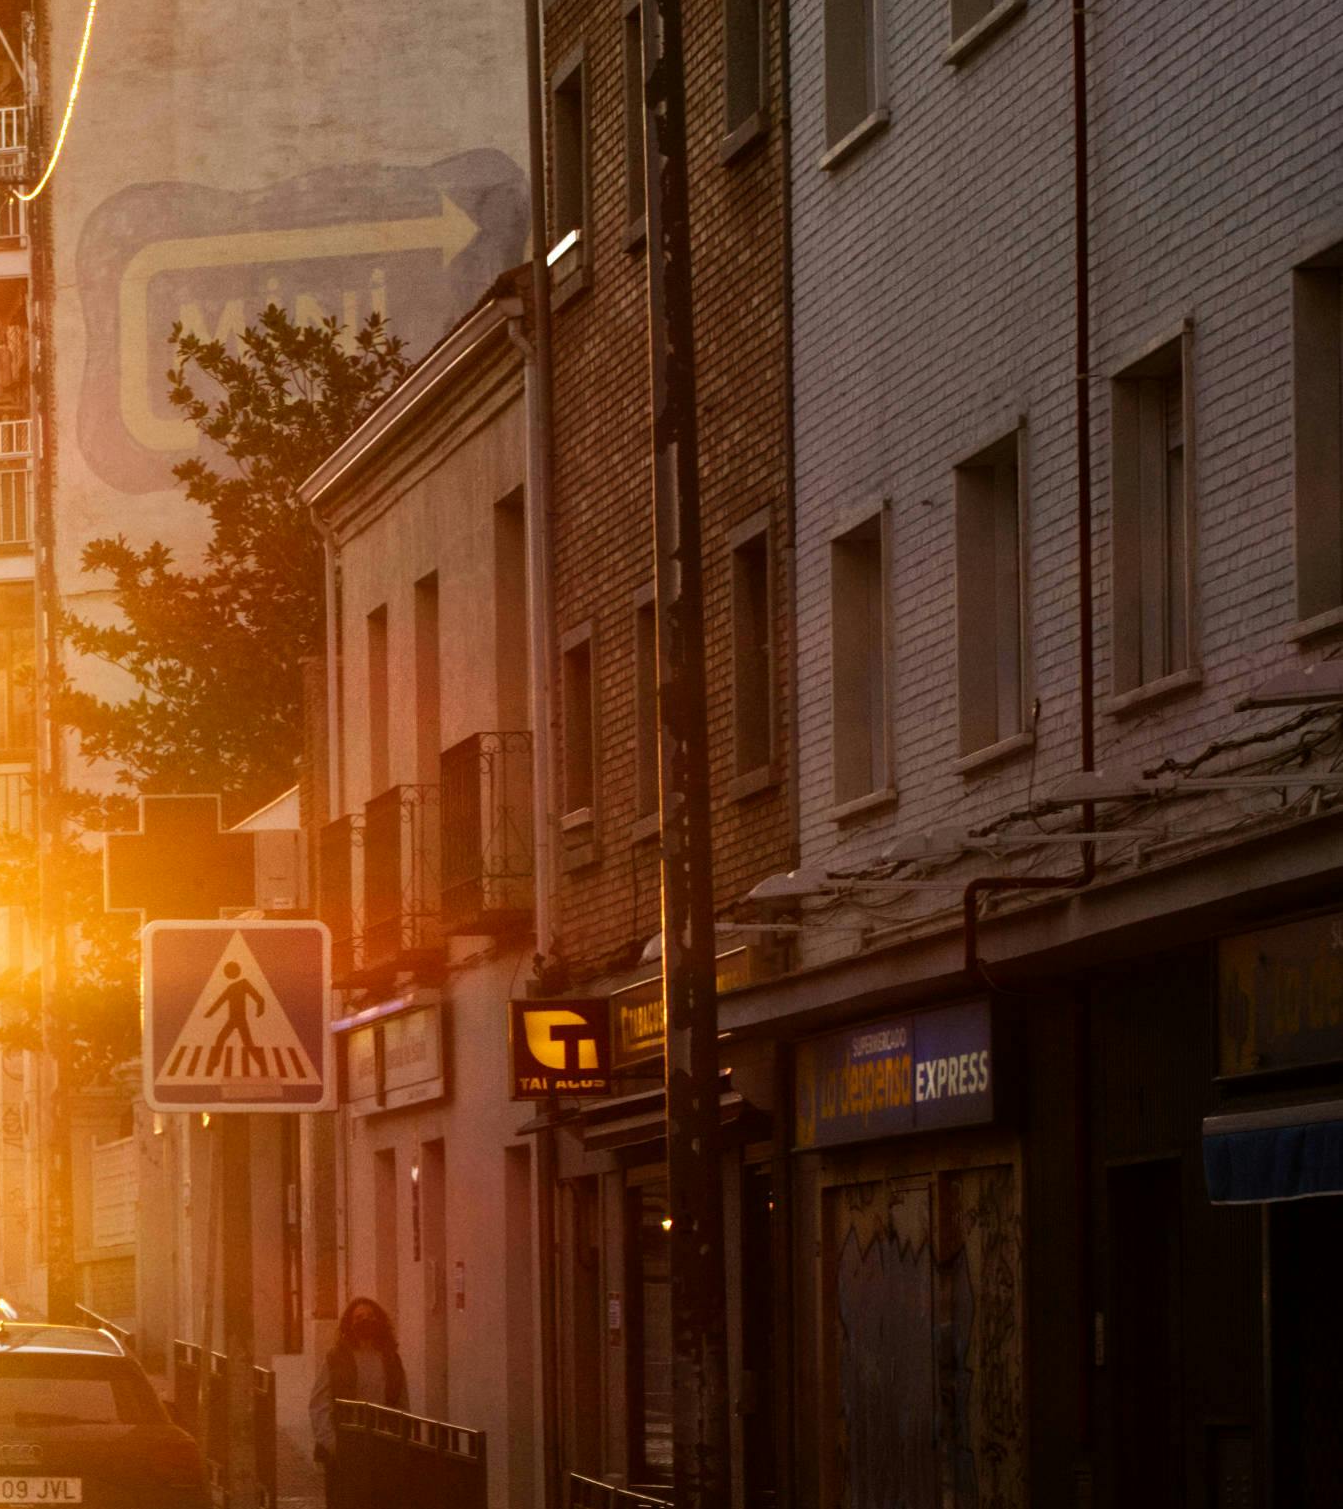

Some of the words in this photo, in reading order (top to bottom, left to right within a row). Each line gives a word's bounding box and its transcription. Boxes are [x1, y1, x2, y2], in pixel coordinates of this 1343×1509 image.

[852, 1027, 907, 1058] SUPERMERCADO
[916, 1049, 989, 1102] EXPRESS
[37, 1479, 76, 1500] JVL
